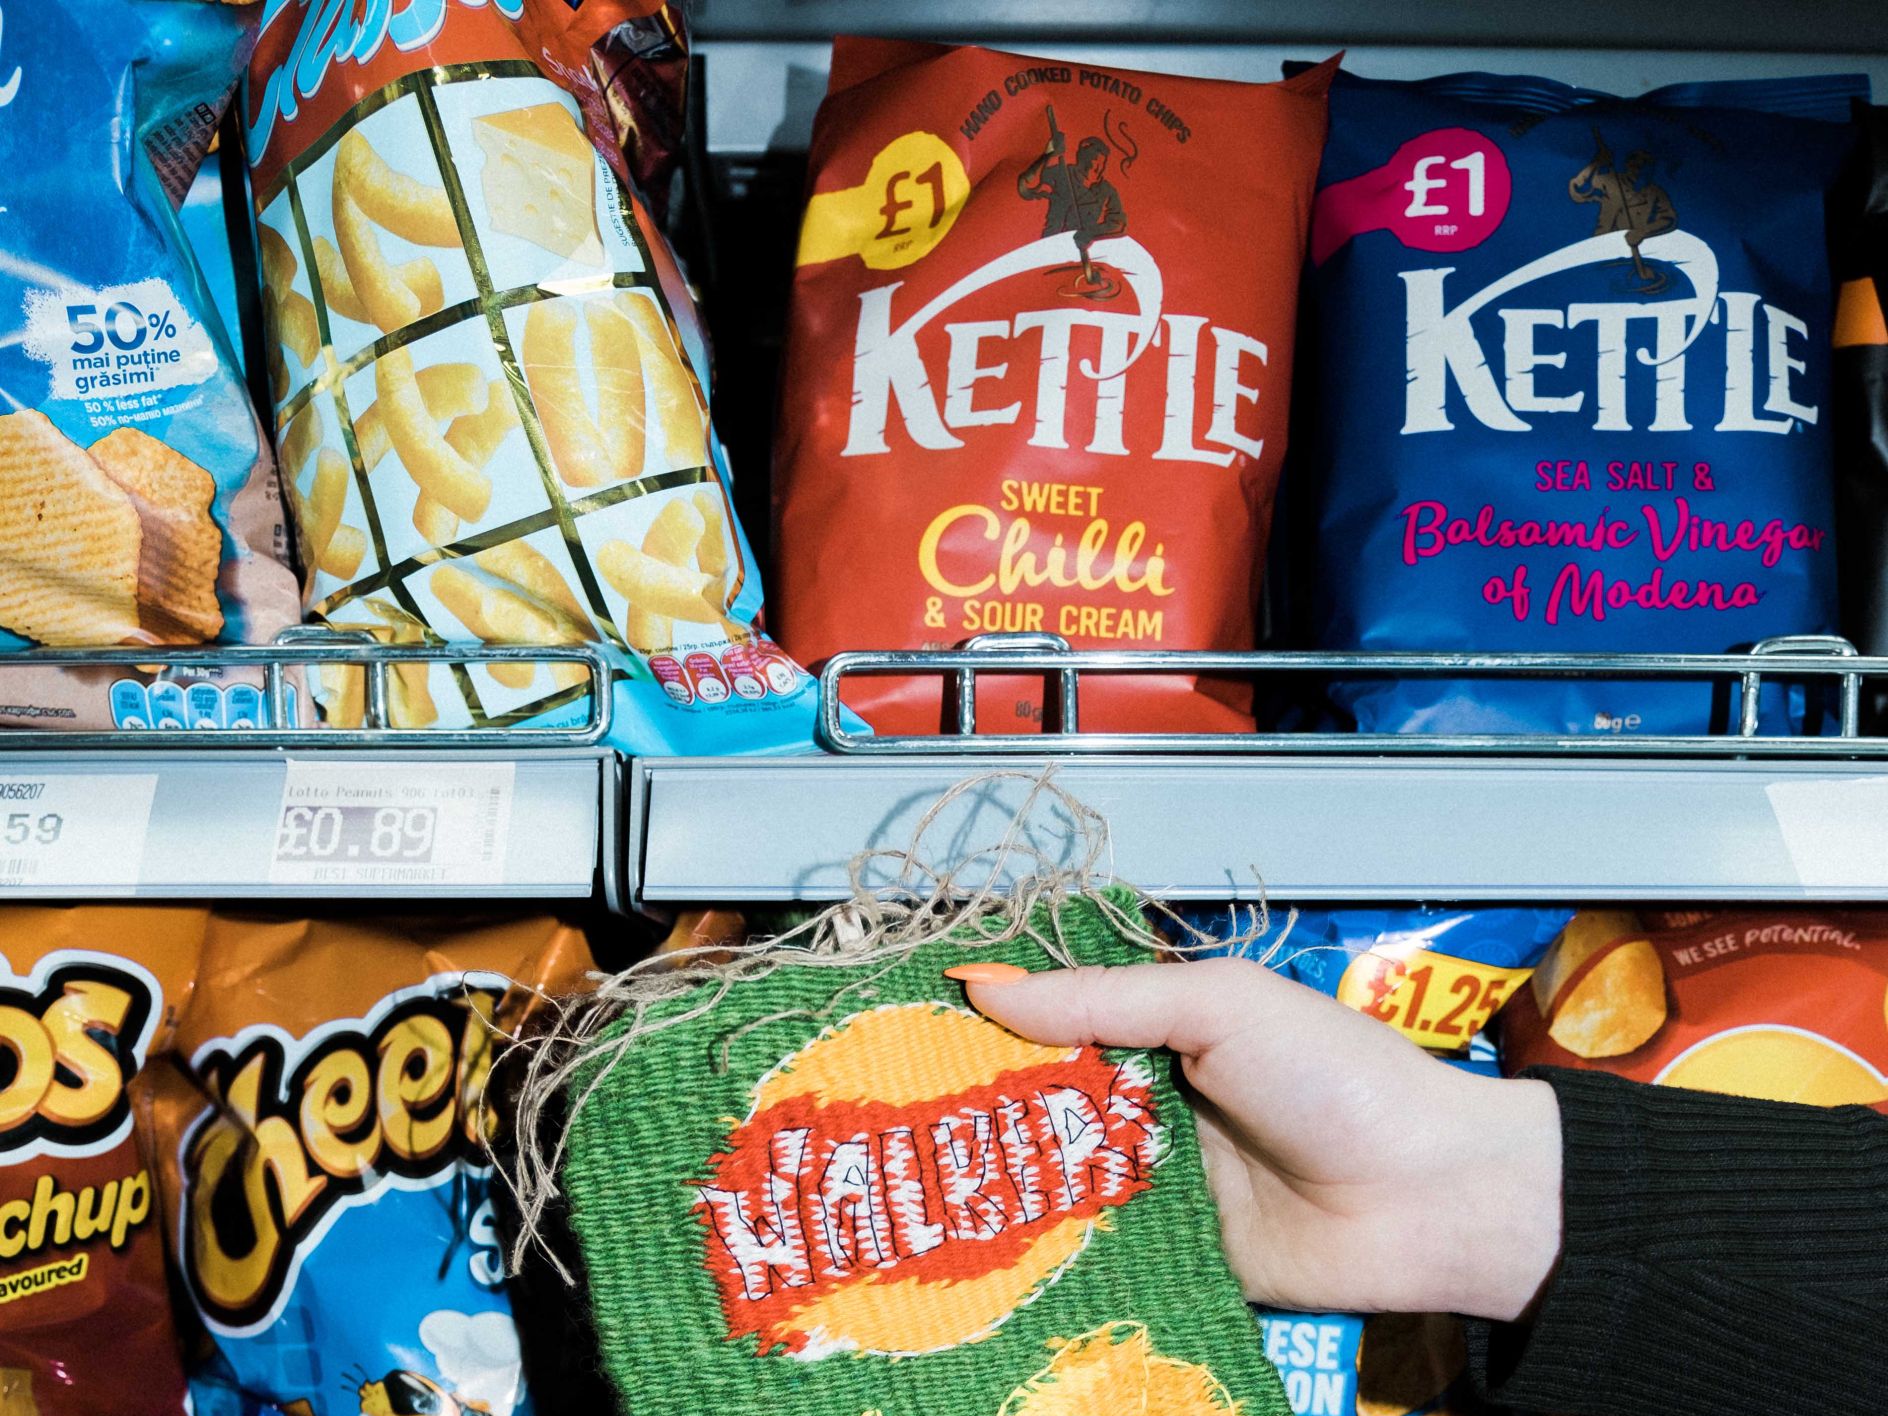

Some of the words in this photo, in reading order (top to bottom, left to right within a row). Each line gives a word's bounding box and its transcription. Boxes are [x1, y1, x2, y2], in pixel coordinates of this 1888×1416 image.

[960, 89, 1003, 141] HAND
[1003, 66, 1073, 96] COOKED
[1078, 68, 1142, 105] POTATO
[1145, 97, 1192, 145] CHIPS
[874, 160, 946, 240] £1
[1404, 151, 1486, 218] £1
[66, 301, 177, 354] 50%
[840, 230, 1268, 468] KETTLE
[1397, 229, 1819, 436] KETTLE
[72, 353, 110, 370] mai
[1001, 480, 1103, 518] SWEET
[1536, 462, 1591, 492] SEA
[1607, 462, 1677, 491] SALT
[1693, 463, 1715, 491] &
[918, 504, 1176, 597] Chilli
[1398, 500, 1640, 565] Balsamic
[1640, 497, 1825, 568] Vinegar
[924, 597, 946, 629] &
[962, 599, 1044, 633] SOUR
[1058, 604, 1163, 642] CREAM
[1482, 566, 1530, 621] of
[1543, 563, 1764, 625] Modena
[280, 807, 436, 857] £0.89
[1673, 946, 1704, 967] WE
[1703, 933, 1739, 958] SEE
[699, 1050, 1174, 1301] WALKERS
[1260, 1319, 1342, 1370] ESE
